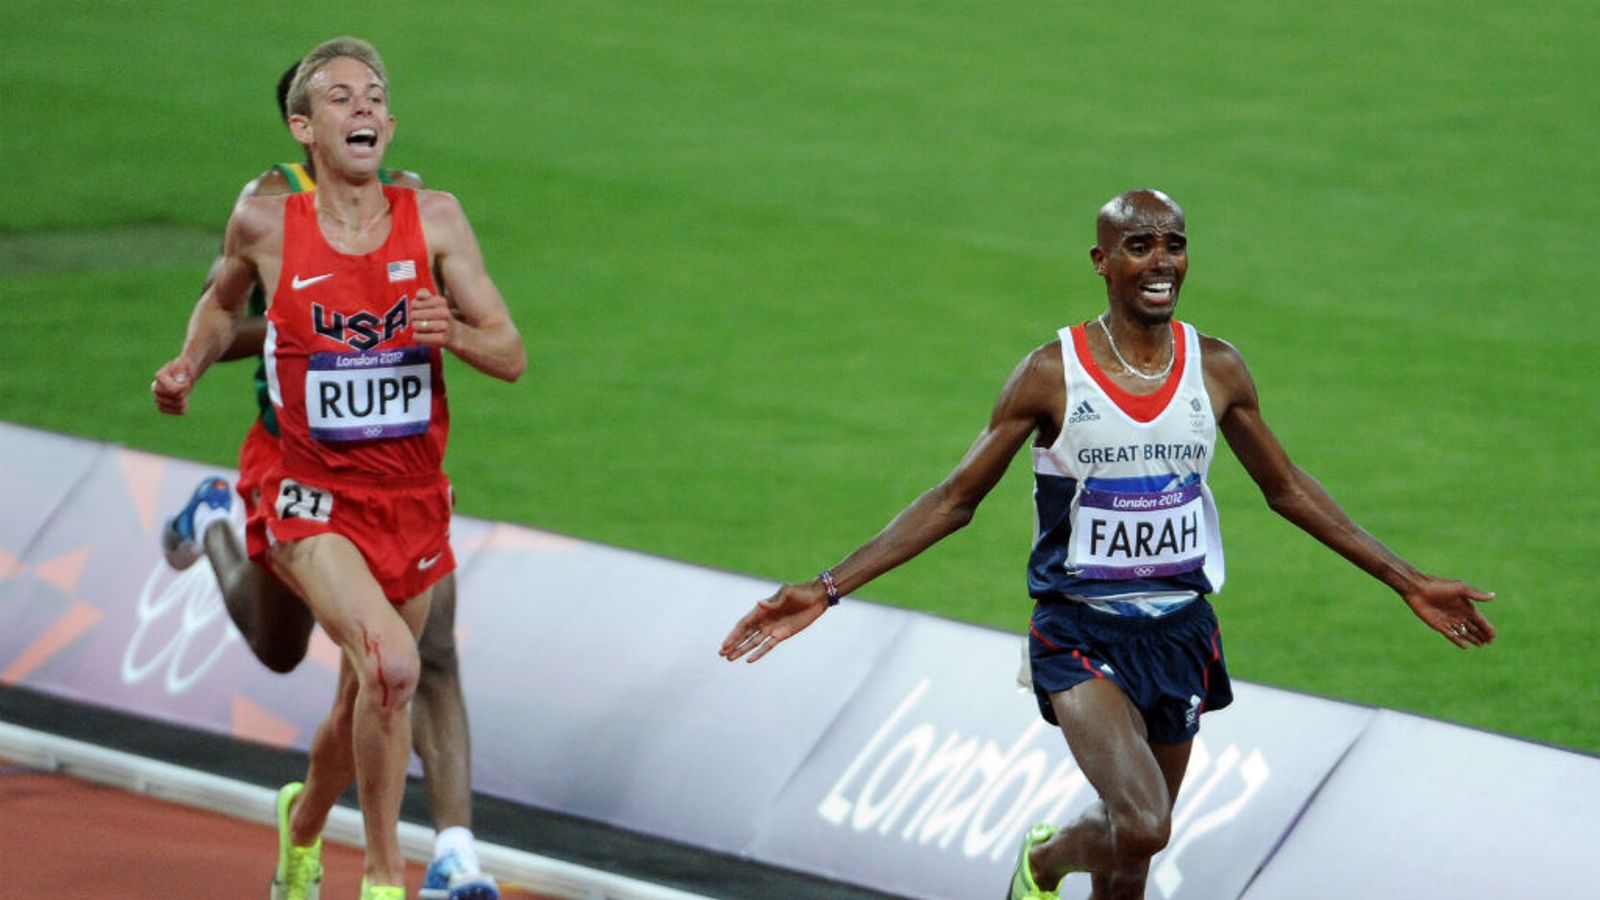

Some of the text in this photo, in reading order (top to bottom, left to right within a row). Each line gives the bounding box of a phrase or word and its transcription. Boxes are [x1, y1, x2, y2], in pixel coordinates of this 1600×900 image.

[311, 294, 408, 352] USA
[336, 351, 404, 367] London 2012
[319, 375, 422, 418] RUPP
[1069, 413, 1101, 424] adidas
[1078, 443, 1208, 464] GREAT BRITAIN
[282, 484, 322, 519] 21
[1112, 492, 1183, 509] London 2012
[1089, 511, 1197, 558] FARAH
